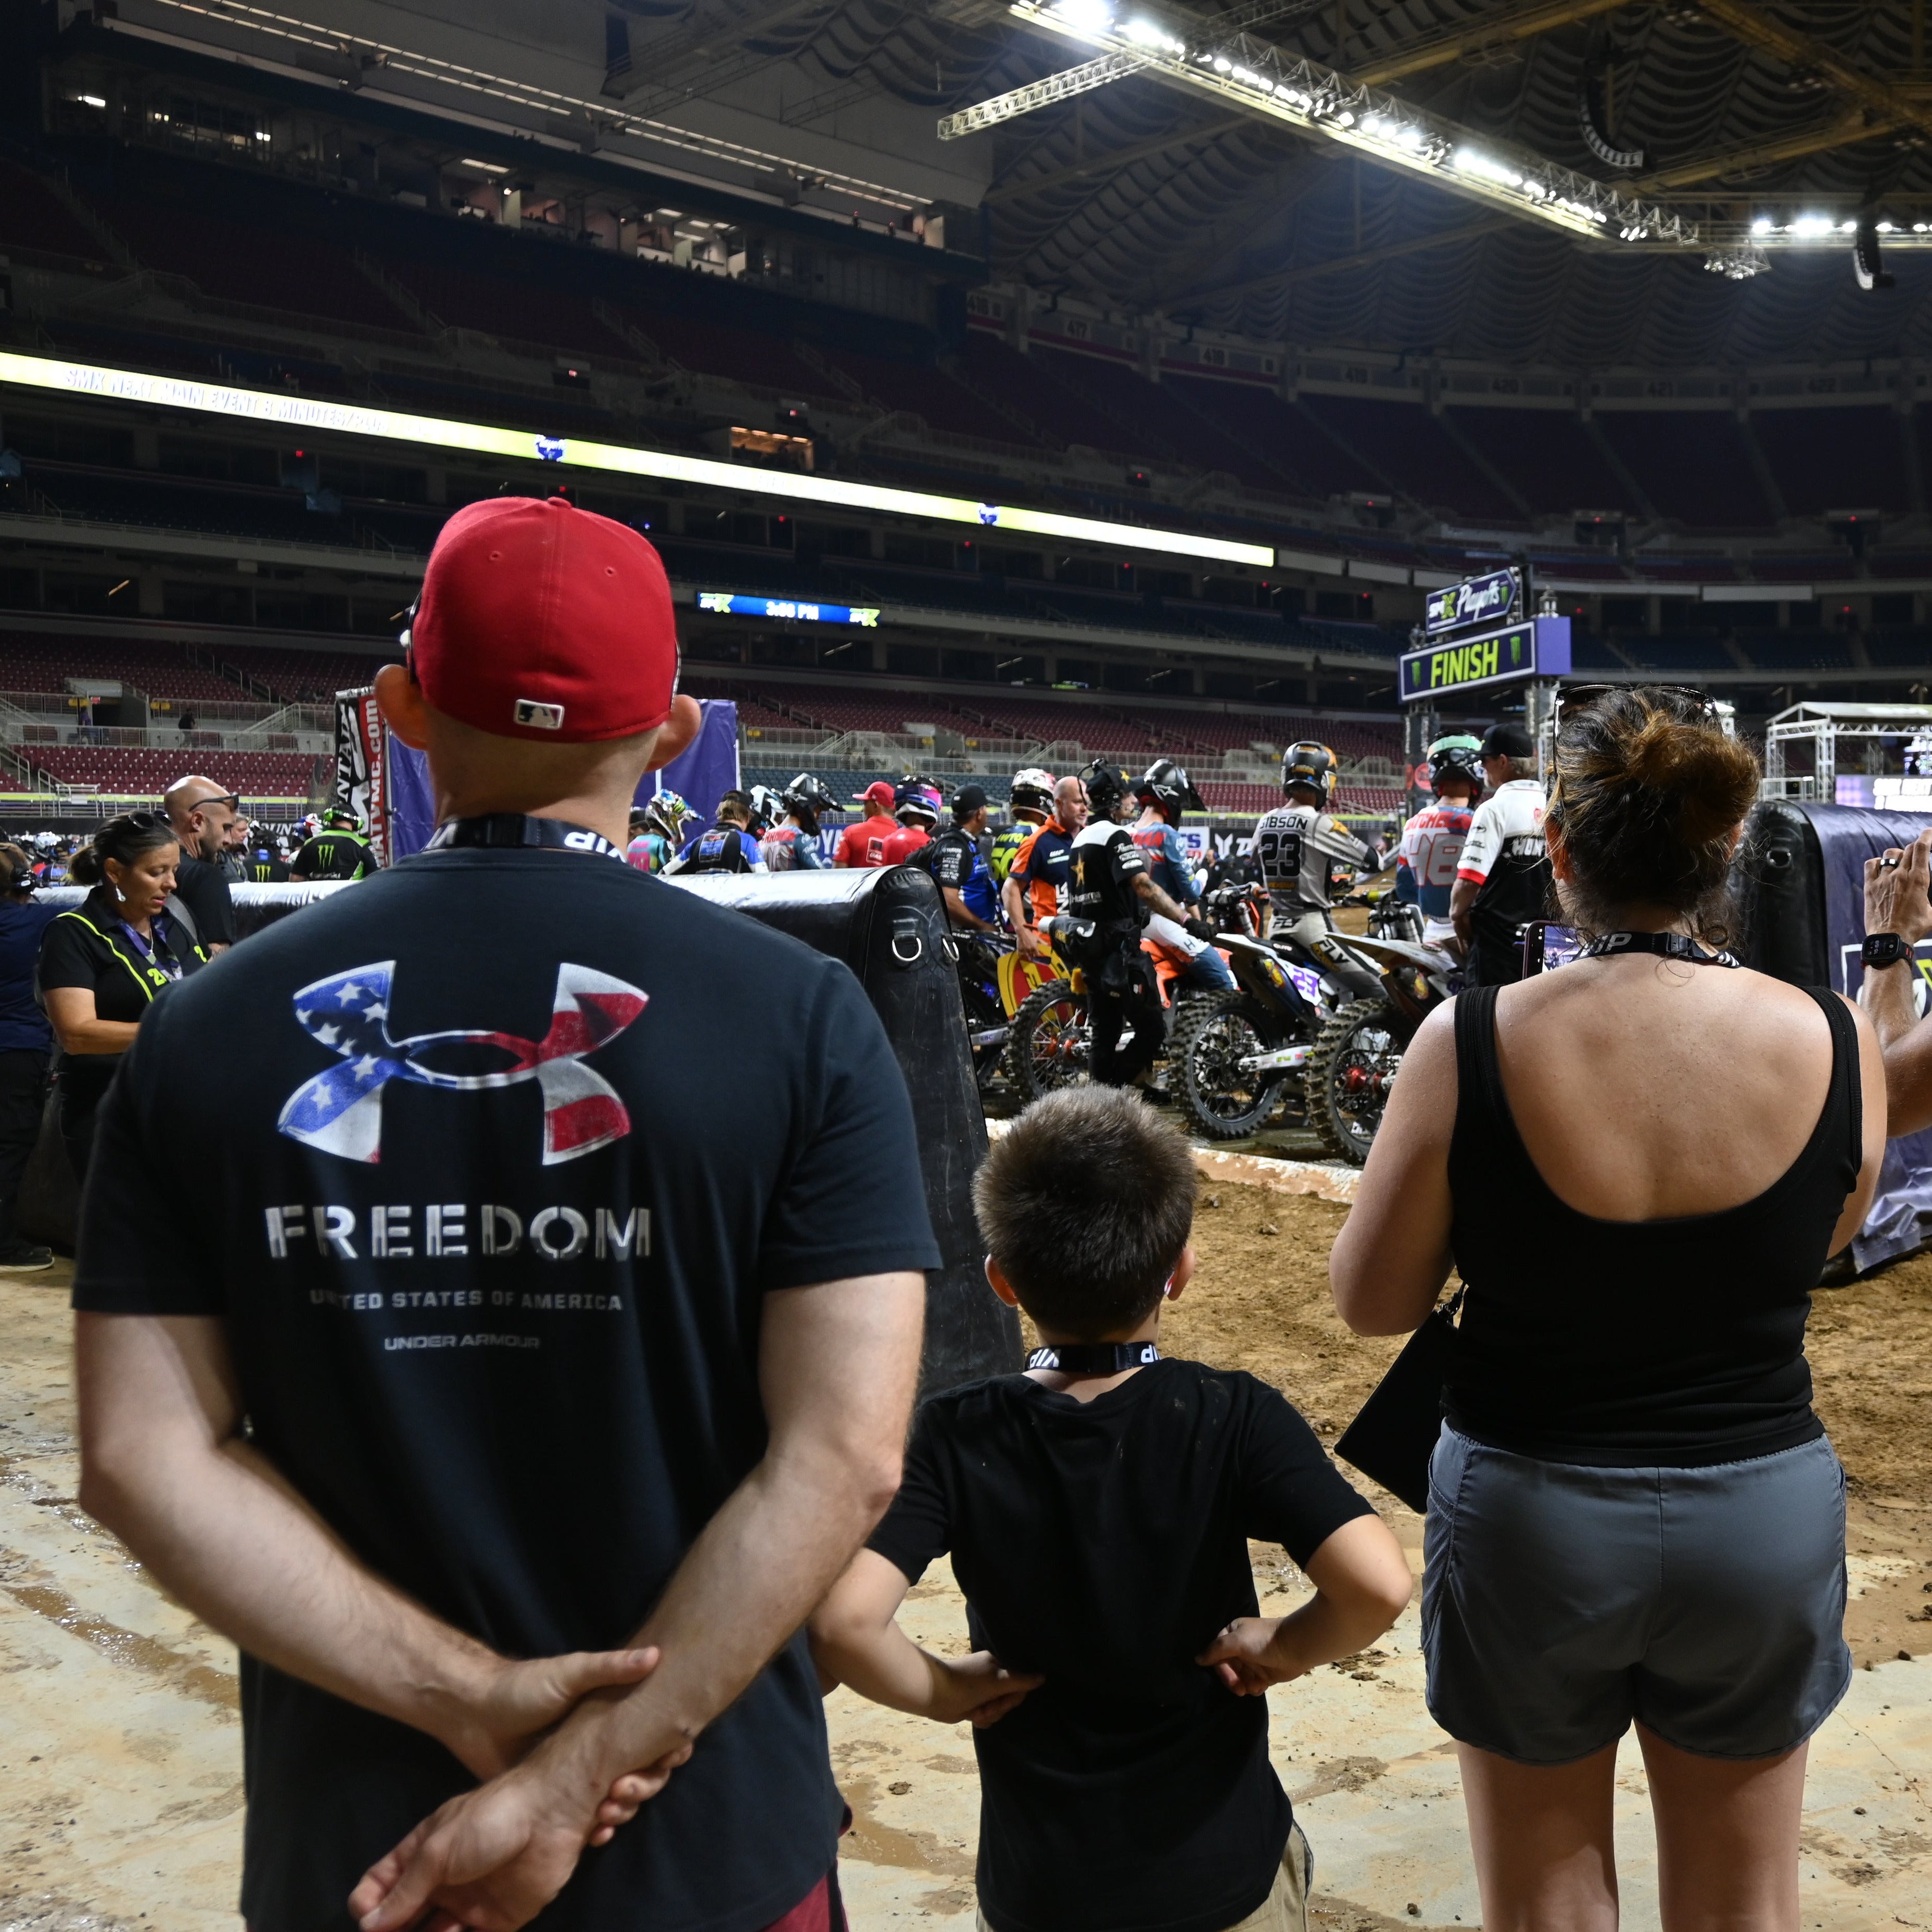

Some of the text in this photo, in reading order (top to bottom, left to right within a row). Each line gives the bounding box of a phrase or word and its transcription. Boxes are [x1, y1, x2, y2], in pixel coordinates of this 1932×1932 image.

[1067, 320, 1087, 339] 417
[63, 368, 106, 391] SMX
[109, 377, 155, 400] NEXT
[159, 382, 205, 407] MAIN
[211, 389, 260, 414] EVENT
[1430, 639, 1499, 688] FINISH
[1260, 833, 1300, 876] 23
[1292, 968, 1320, 998] 23
[265, 1203, 651, 1261] FREEDOM
[391, 1290, 482, 1307] STATES
[492, 1290, 514, 1306] OF
[521, 1293, 622, 1311] AMERICA
[384, 1334, 540, 1351] UNDER ARMOUR
